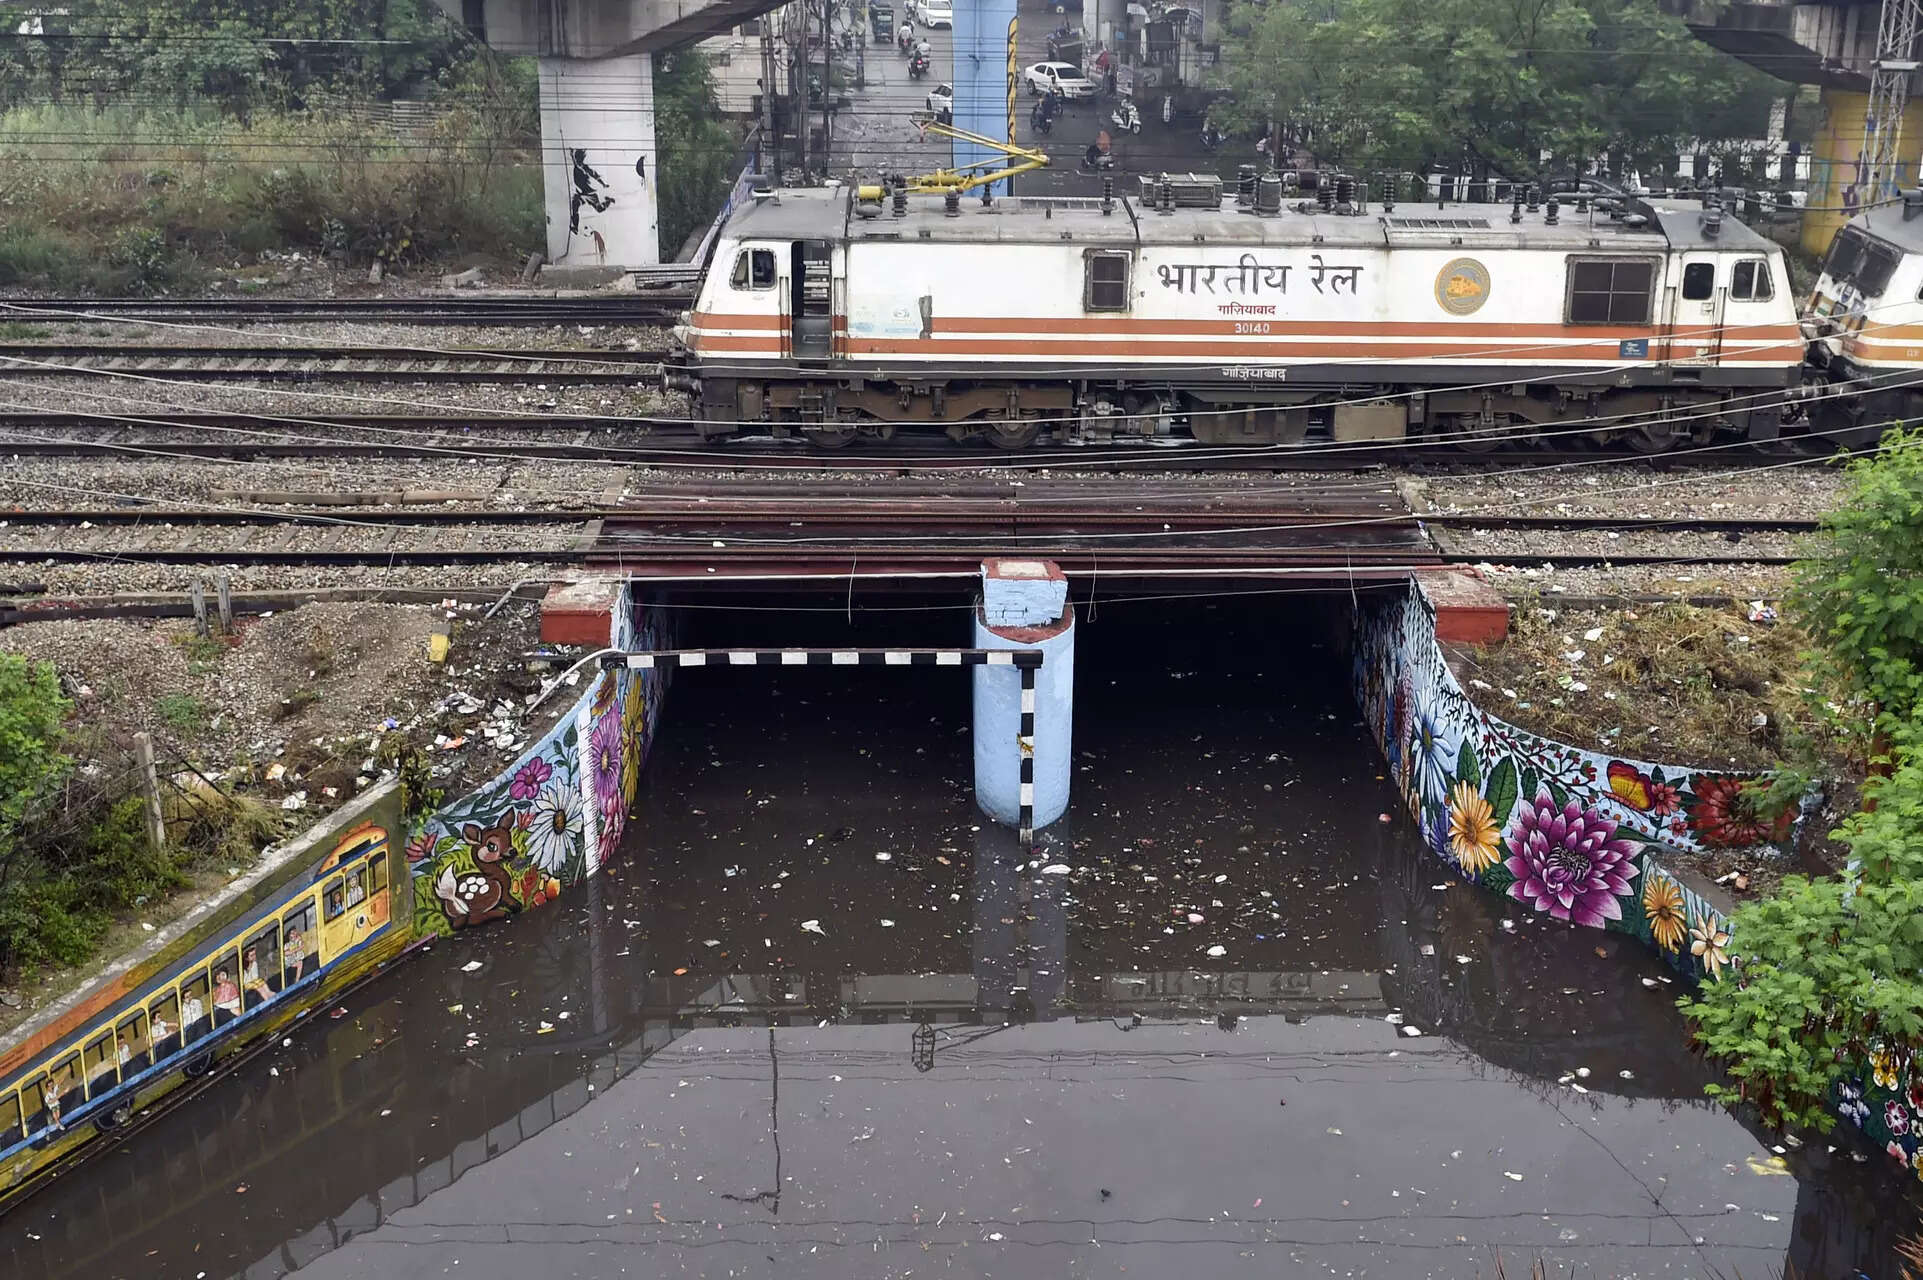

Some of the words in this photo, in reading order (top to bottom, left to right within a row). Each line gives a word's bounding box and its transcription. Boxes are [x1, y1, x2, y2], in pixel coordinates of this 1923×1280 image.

[1157, 253, 1292, 295] भारतीय
[1308, 254, 1364, 295] रेल
[1234, 322, 1270, 334] 30140
